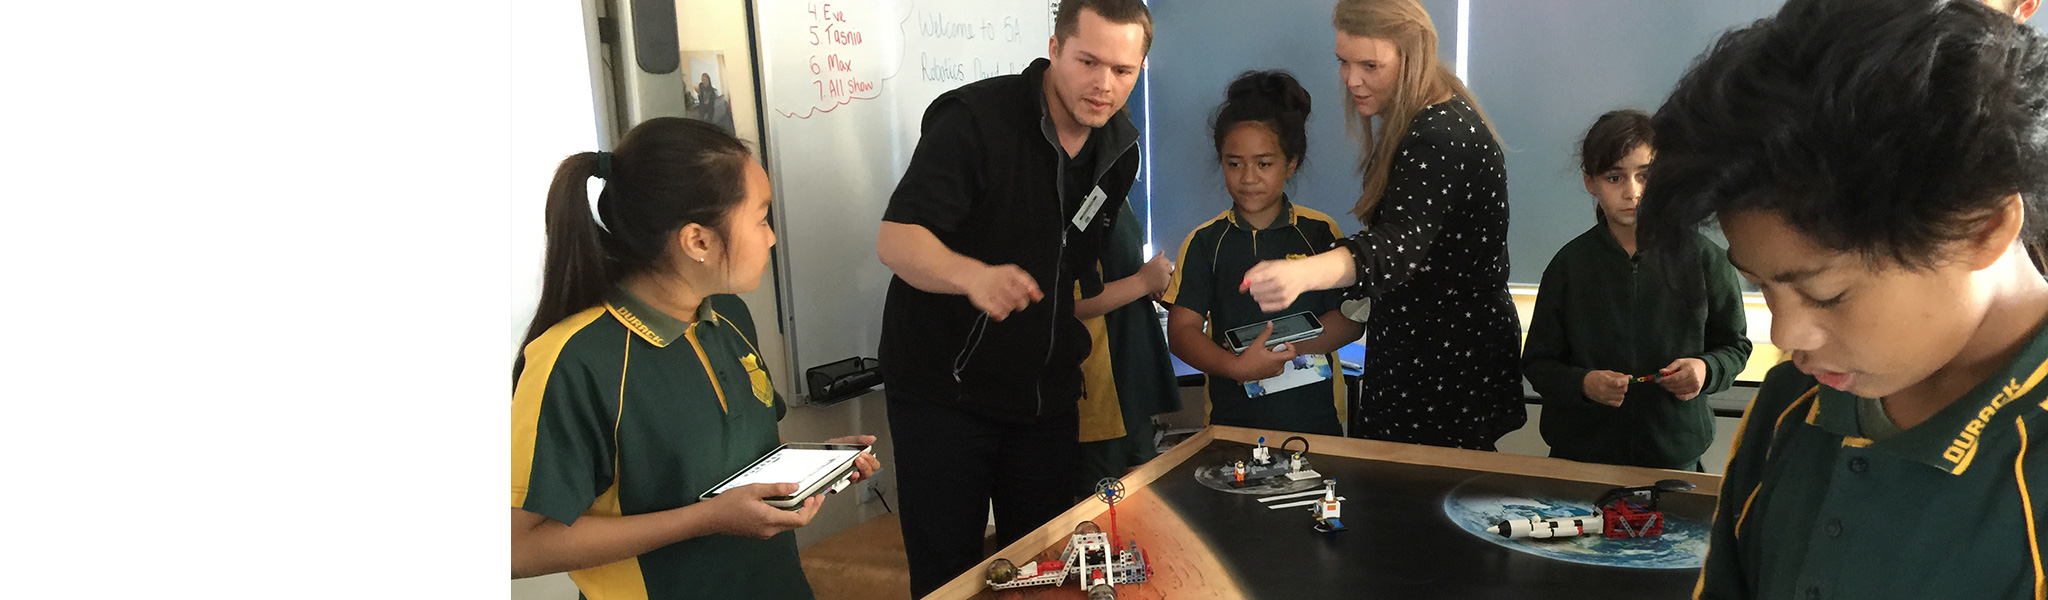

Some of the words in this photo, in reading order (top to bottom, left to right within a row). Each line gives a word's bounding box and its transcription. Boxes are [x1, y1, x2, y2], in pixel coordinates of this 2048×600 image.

[823, 3, 846, 23] Eve
[918, 9, 975, 40] Welcome
[980, 18, 995, 41] to
[1004, 15, 1022, 44] 5A
[825, 23, 863, 46] Tasnia
[827, 53, 852, 73] Max
[921, 51, 965, 82] Robotics
[829, 78, 844, 98] All
[616, 306, 664, 343] DURACK
[1943, 377, 2021, 464] DURACK
